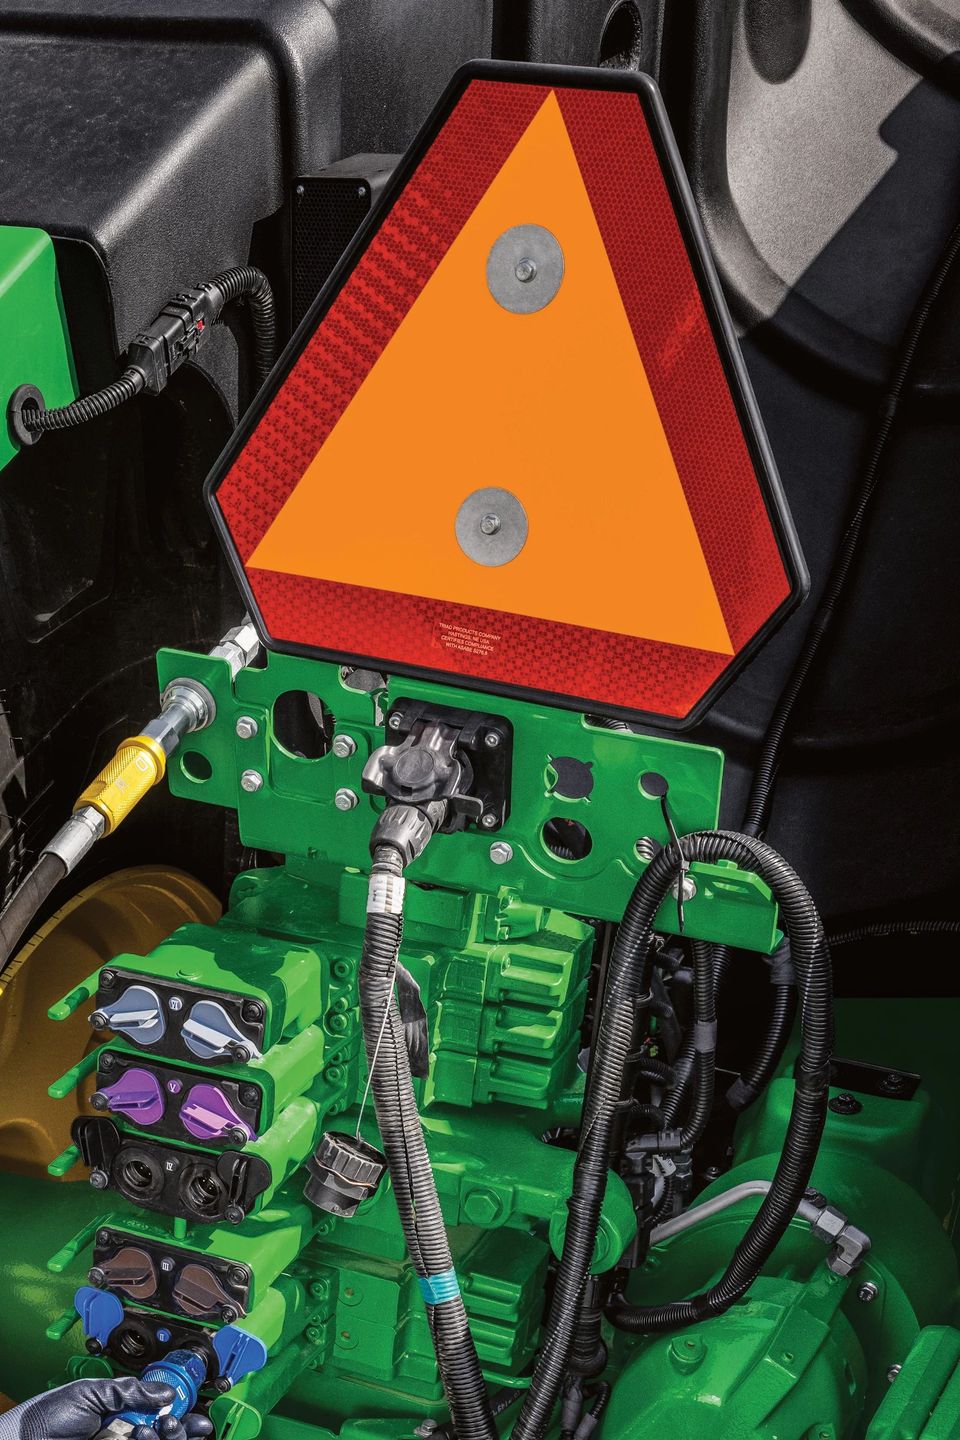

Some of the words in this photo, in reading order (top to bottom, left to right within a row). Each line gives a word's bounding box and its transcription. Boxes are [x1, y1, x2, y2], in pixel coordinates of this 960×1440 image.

[439, 622, 452, 630] TRIAD
[453, 625, 479, 636] PRODUCTS
[478, 631, 501, 641] COMPANY
[441, 634, 465, 644] CERTIFIES
[465, 640, 494, 651] COMPLIANCE
